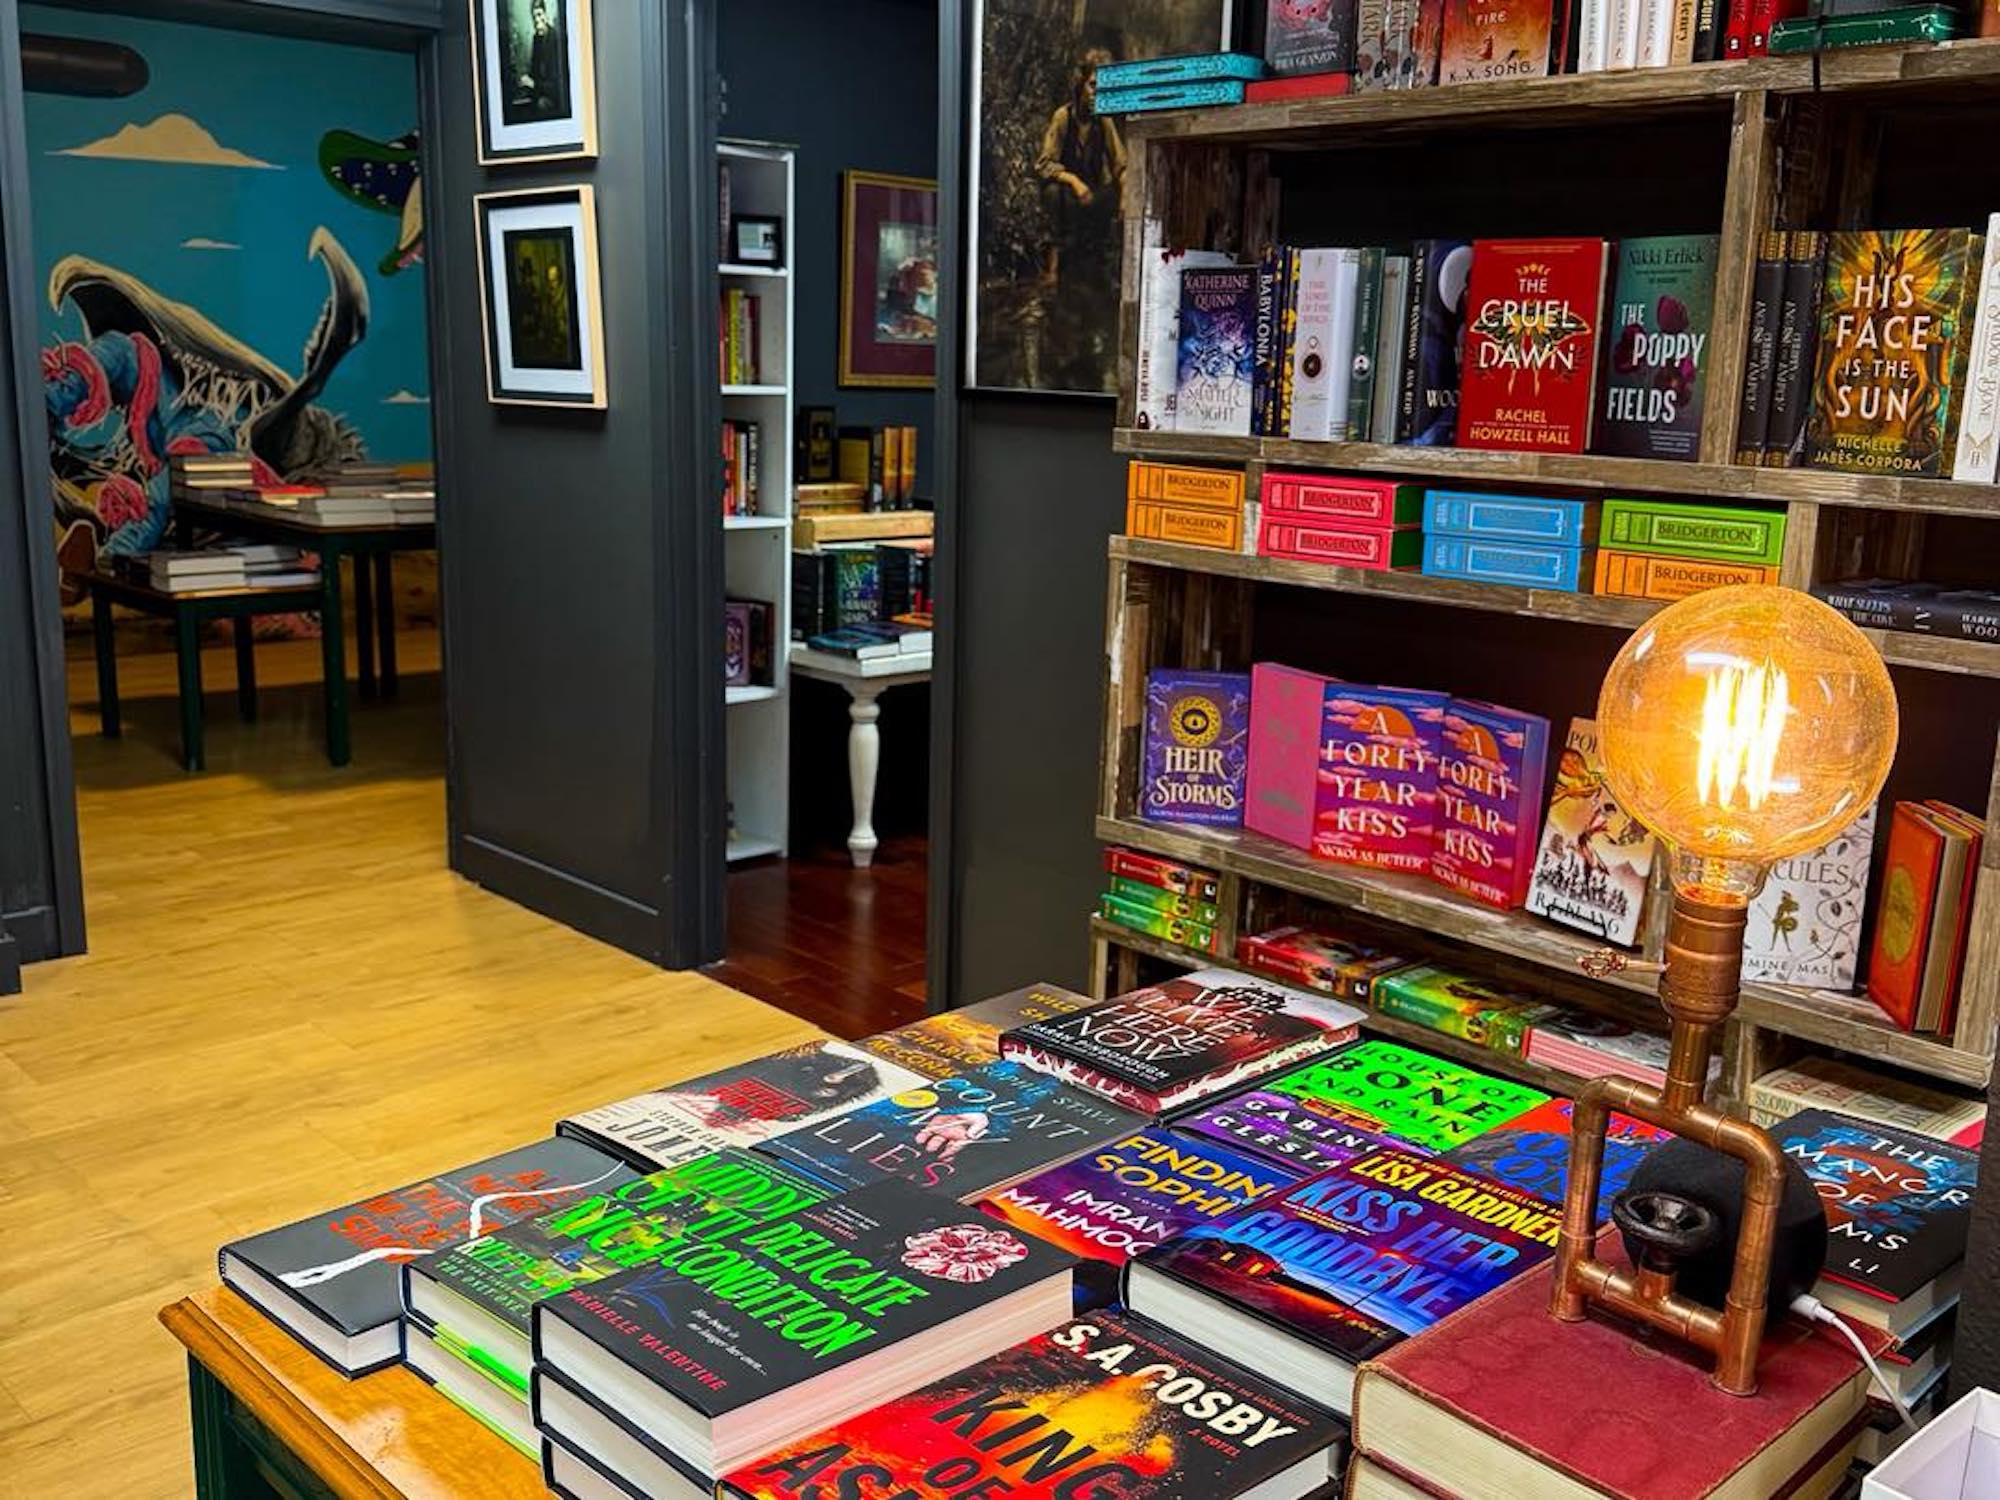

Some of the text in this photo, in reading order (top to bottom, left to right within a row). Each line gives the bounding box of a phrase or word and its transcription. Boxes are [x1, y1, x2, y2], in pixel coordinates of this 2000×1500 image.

[1475, 11, 1506, 26] FIRE
[1484, 60, 1536, 79] SONG
[1184, 275, 1249, 290] KATHERINE
[1518, 278, 1548, 293] THE
[1853, 273, 1915, 309] HIS
[1255, 274, 1273, 367] BABYLONIA
[1480, 299, 1576, 329] CRUEL
[1621, 303, 1646, 325] THE
[1632, 332, 1705, 368] POPPY
[1836, 315, 1931, 351] FACE
[1478, 341, 1576, 370] DAWN
[1844, 358, 1910, 379] IS THE
[1495, 408, 1547, 424] RACHEL
[1606, 387, 1676, 423] FIELDS
[1835, 385, 1909, 422] SUN
[1469, 426, 1571, 445] HOWZELL HALL
[1835, 437, 1902, 452] MICHELLE
[1856, 453, 1922, 472] CORPORA
[1166, 475, 1232, 491] BRIDGERTON
[1164, 514, 1228, 530] BRIDGERTON
[1657, 521, 1753, 543] BRIDGERTON
[1653, 565, 1750, 585] BRIDGERTON
[1371, 711, 1388, 735] A
[1326, 739, 1427, 774] FORTY
[1473, 732, 1483, 756] A
[1165, 746, 1229, 781] HEIR
[1439, 755, 1510, 801] FORTY
[1150, 774, 1238, 811] STORMS
[1335, 775, 1417, 807] YEAR
[1337, 808, 1408, 839] KISS
[1441, 794, 1501, 836] YEAR
[1445, 828, 1495, 869] KISS
[1320, 1055, 1506, 1125] BONE
[814, 1117, 956, 1189] LIES
[1113, 1136, 1281, 1200] FINDIN
[1870, 1137, 1951, 1172] THE
[1348, 1155, 1433, 1192] LISA
[1784, 1144, 1970, 1206] MANOR
[1286, 1175, 1424, 1233] KISS
[1812, 1181, 1877, 1206] OF
[1063, 1188, 1180, 1241] IMRAN
[1221, 1210, 1472, 1321] GOODBYE
[1391, 1220, 1521, 1275] HER
[740, 1217, 931, 1317] DELICATE
[568, 1288, 642, 1337] DANIELLE
[664, 1242, 877, 1359] CONDITION
[638, 1332, 729, 1392] VALENTINE
[1131, 1363, 1299, 1448] COSBY
[929, 1389, 1141, 1500] KING
[755, 1441, 911, 1500] AS
